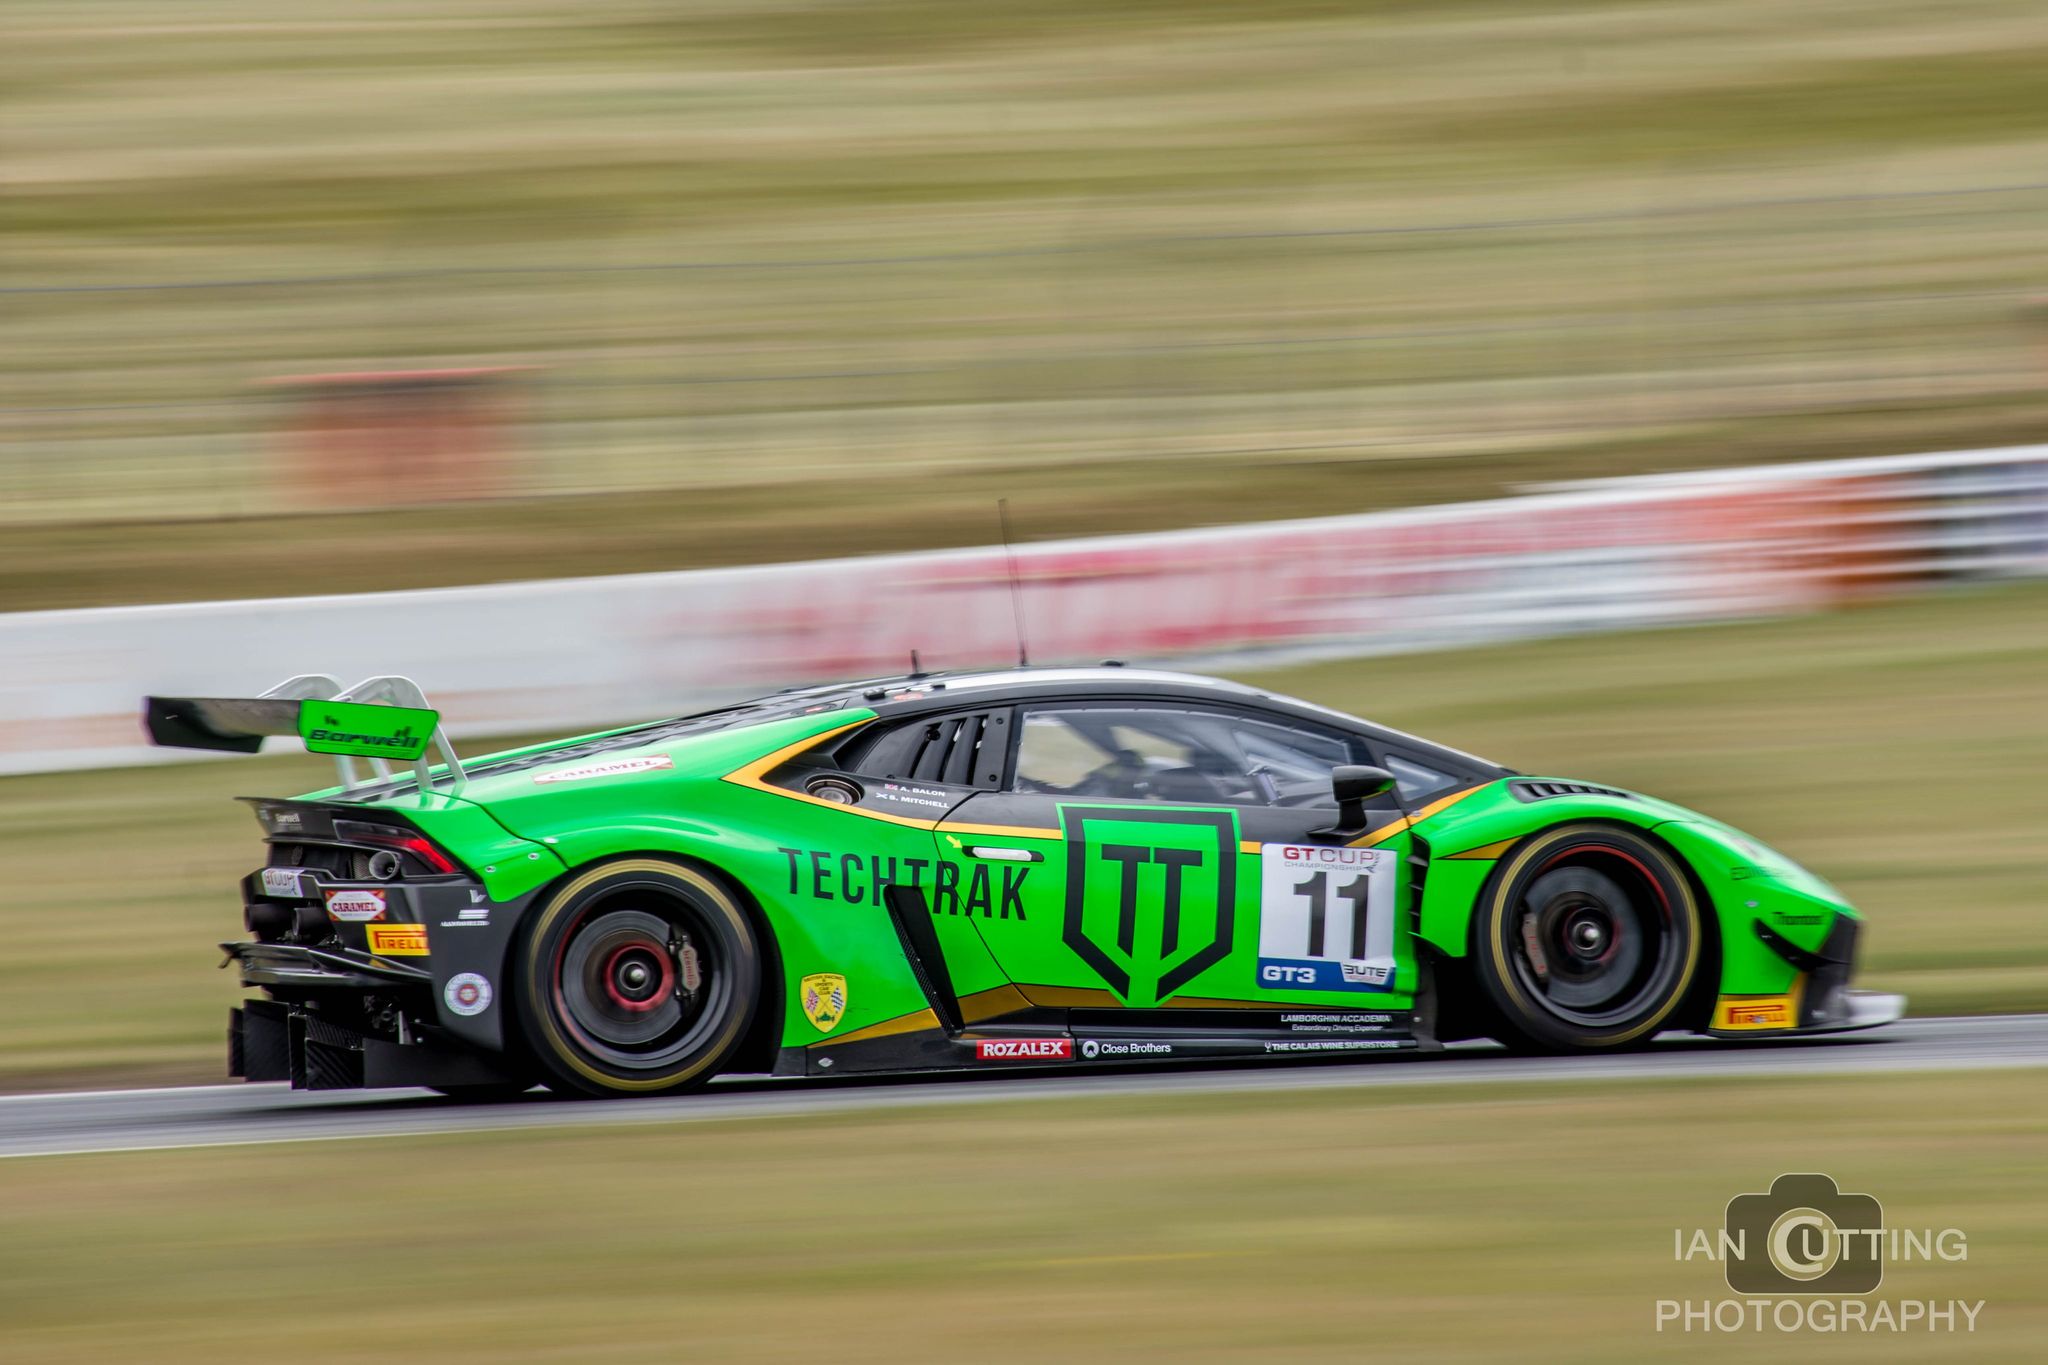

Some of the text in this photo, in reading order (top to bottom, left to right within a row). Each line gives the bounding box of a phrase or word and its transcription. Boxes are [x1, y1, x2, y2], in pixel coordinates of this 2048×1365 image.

[310, 728, 421, 748] Barwell
[549, 760, 656, 780] CARAMEL
[912, 787, 946, 797] BALON
[901, 796, 950, 808] MITCHELL
[1283, 847, 1374, 865] GT CUP
[1284, 861, 1363, 872] CHAMPIONSHIP
[777, 846, 1030, 921] TECHTRAK
[332, 902, 378, 913] CARAMEL
[1293, 871, 1369, 960] 11
[1262, 965, 1317, 984] GT3
[1281, 1014, 1393, 1023] LAMBORGHINI ACCADEMIA
[1291, 1023, 1332, 1032] Extraordinary
[1333, 1024, 1354, 1032] Driving
[983, 1041, 1064, 1057] ROZALEX
[1101, 1042, 1171, 1054] Close Brothers
[1272, 1041, 1400, 1051] THE CALAIS WINE SUPERSTORE
